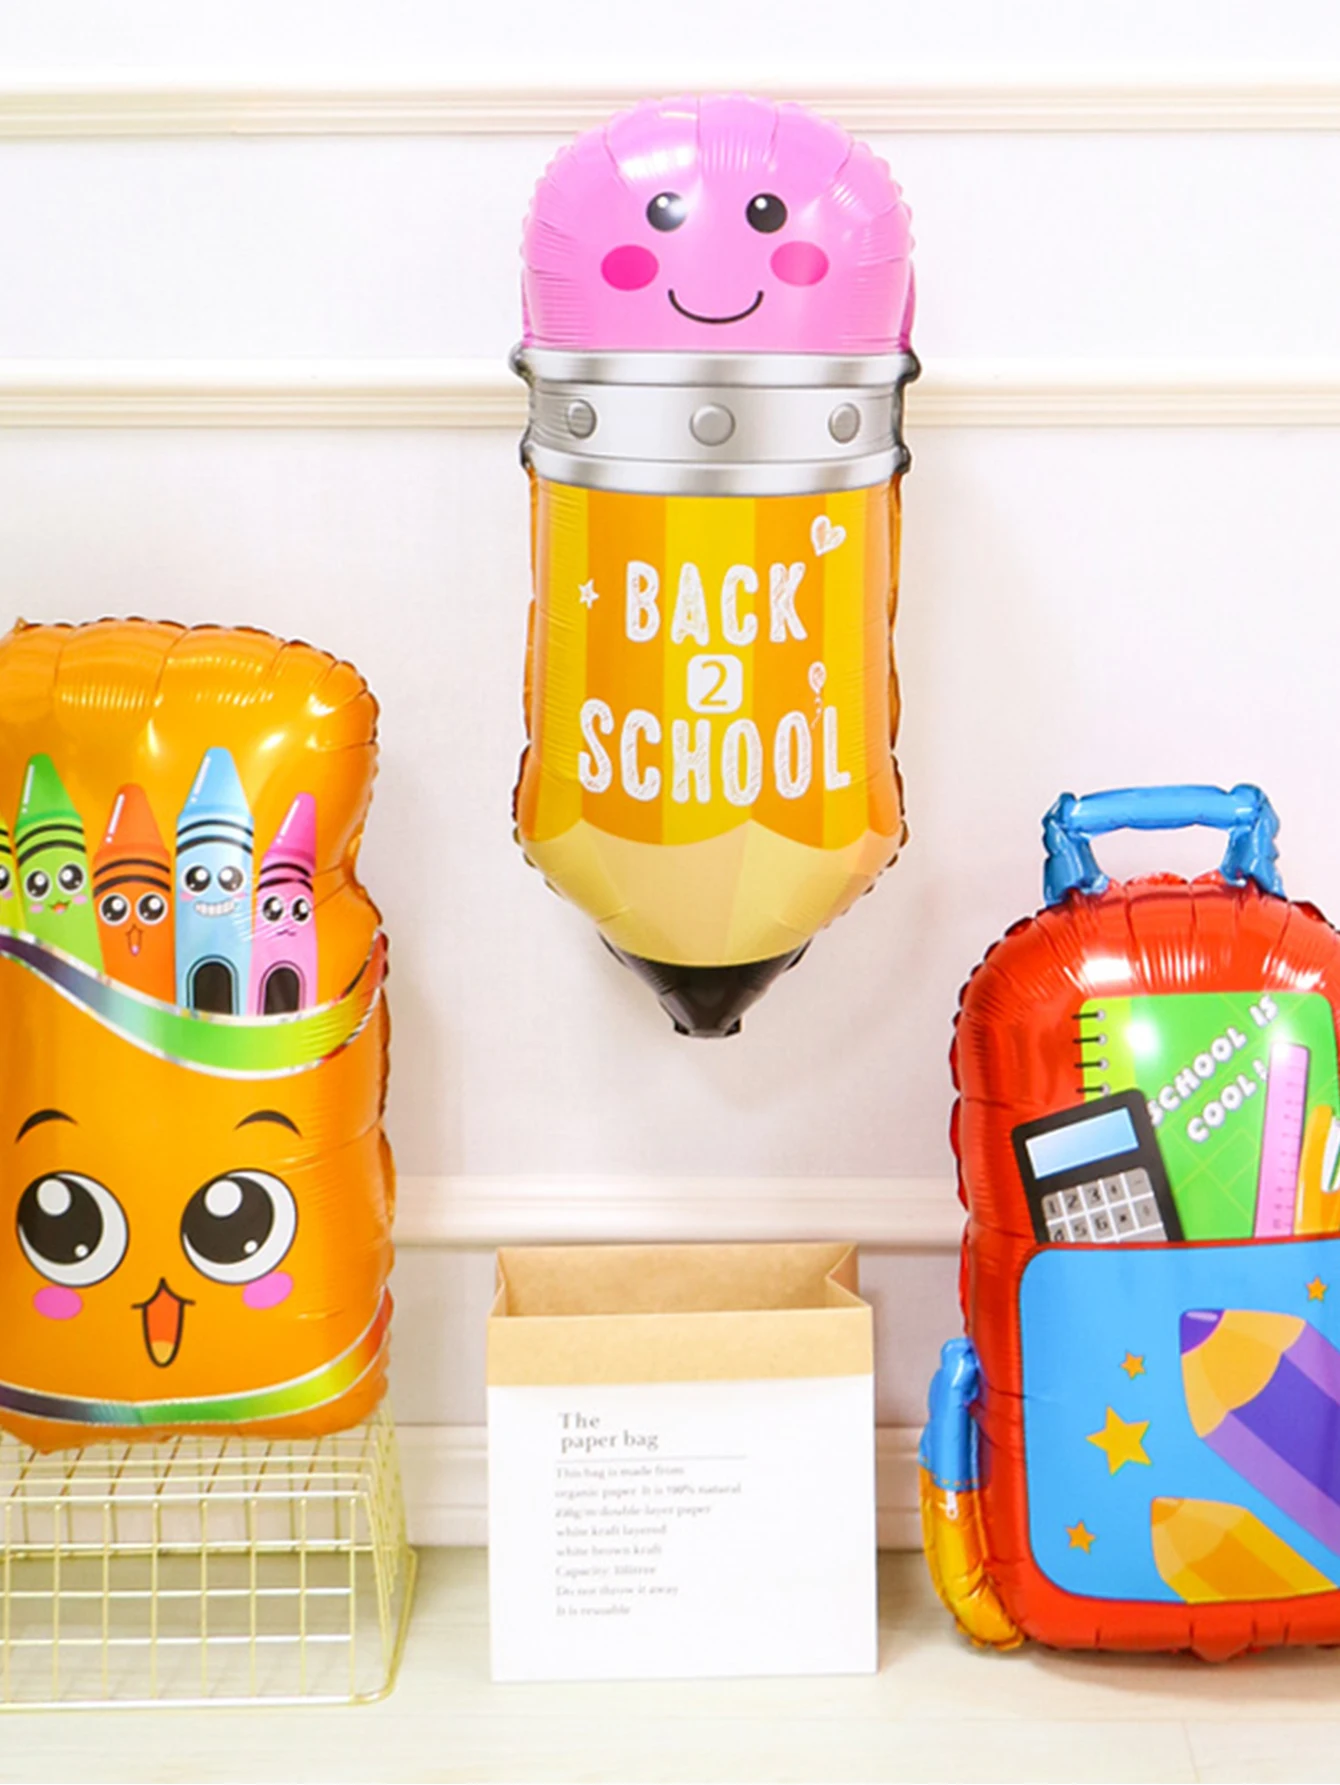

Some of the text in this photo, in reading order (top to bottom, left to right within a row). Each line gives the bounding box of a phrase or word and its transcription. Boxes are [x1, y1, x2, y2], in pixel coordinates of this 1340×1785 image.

[625, 560, 807, 646] BACK
[699, 660, 728, 706] 2
[578, 697, 850, 806] SCHOOL
[1249, 995, 1279, 1028] IS
[557, 1411, 601, 1430] The
[559, 1428, 659, 1454] paper bag
[584, 1467, 606, 1481] bag
[620, 1465, 653, 1477] made
